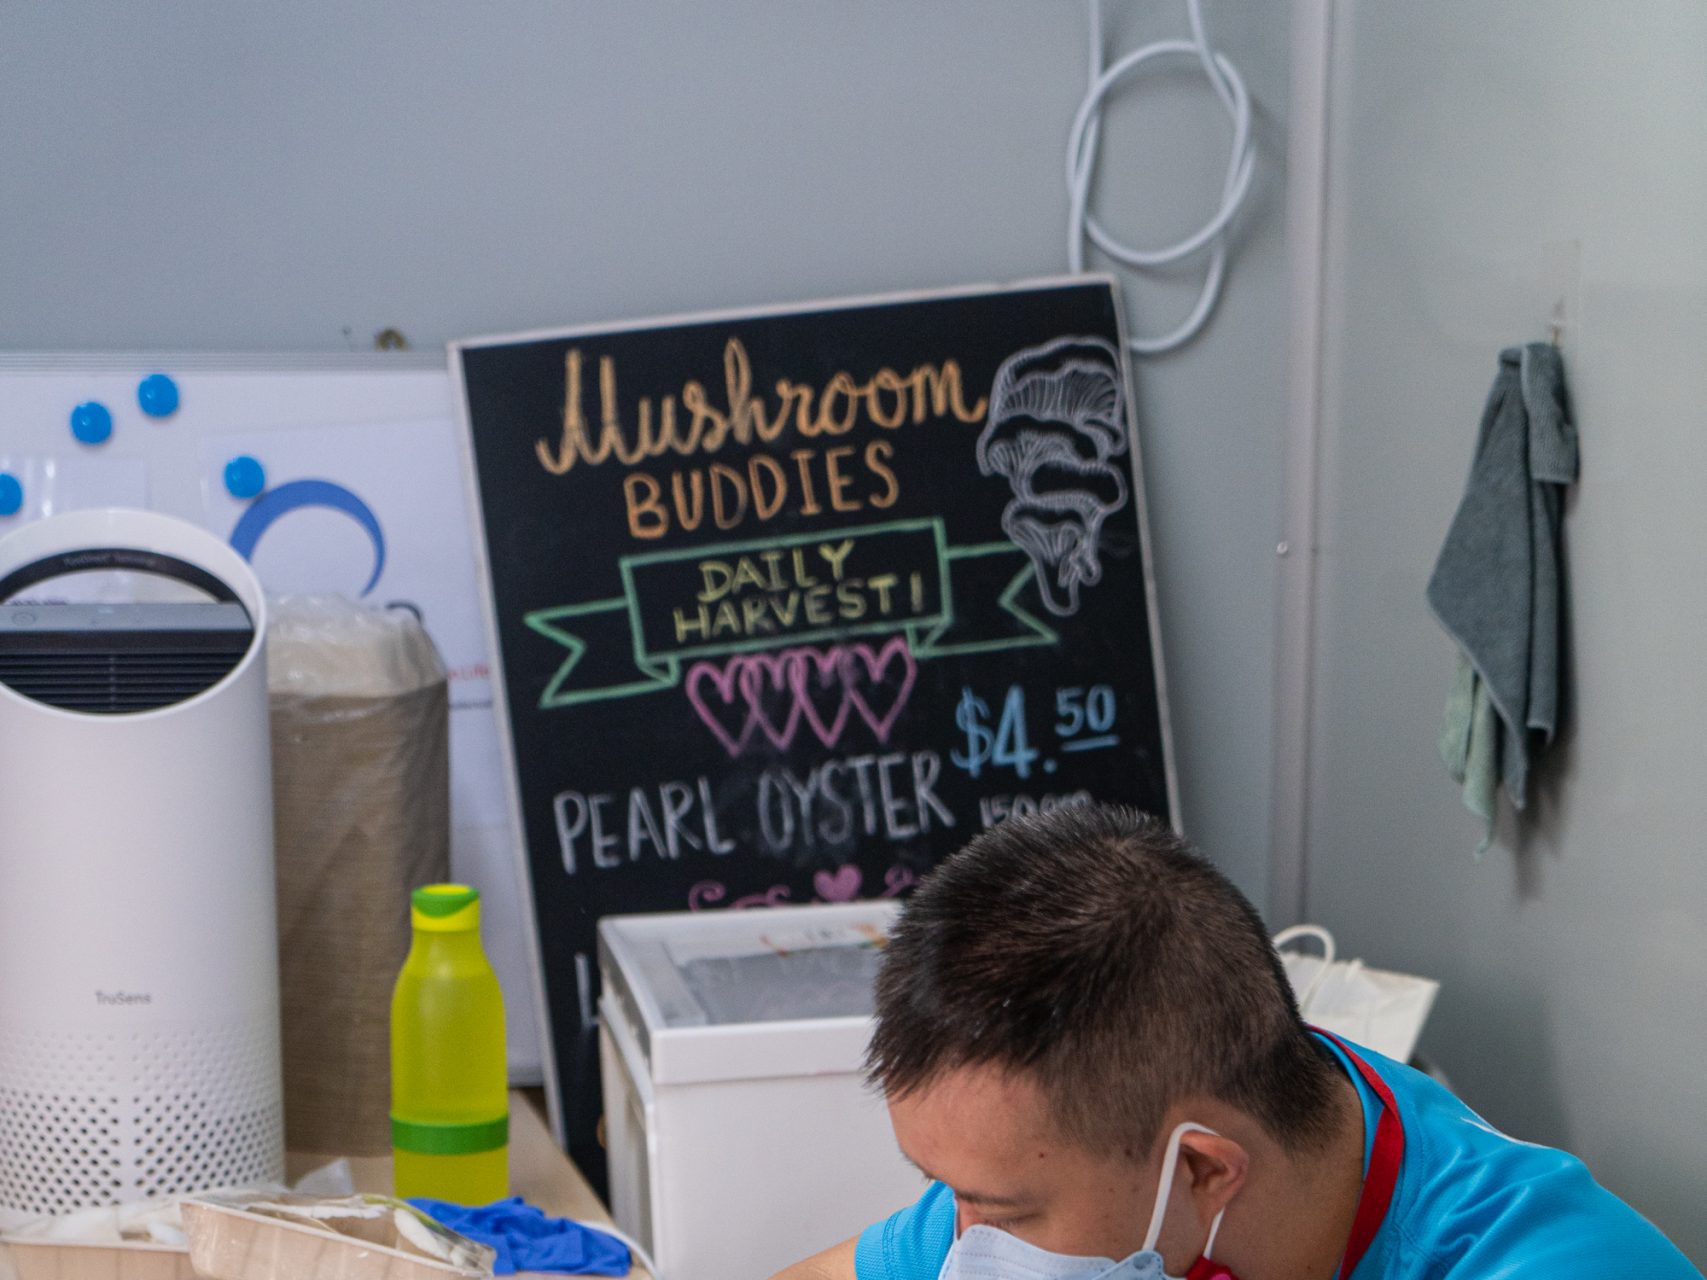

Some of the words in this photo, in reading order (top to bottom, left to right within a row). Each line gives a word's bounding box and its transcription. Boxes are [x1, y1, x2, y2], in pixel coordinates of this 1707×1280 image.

[535, 338, 988, 475] Mushroom
[623, 440, 900, 540] BUDDIES
[697, 540, 855, 603] DAILY
[552, 776, 736, 876] PEARL
[757, 751, 957, 852] OYSTER
[95, 989, 152, 1006] TruSens
